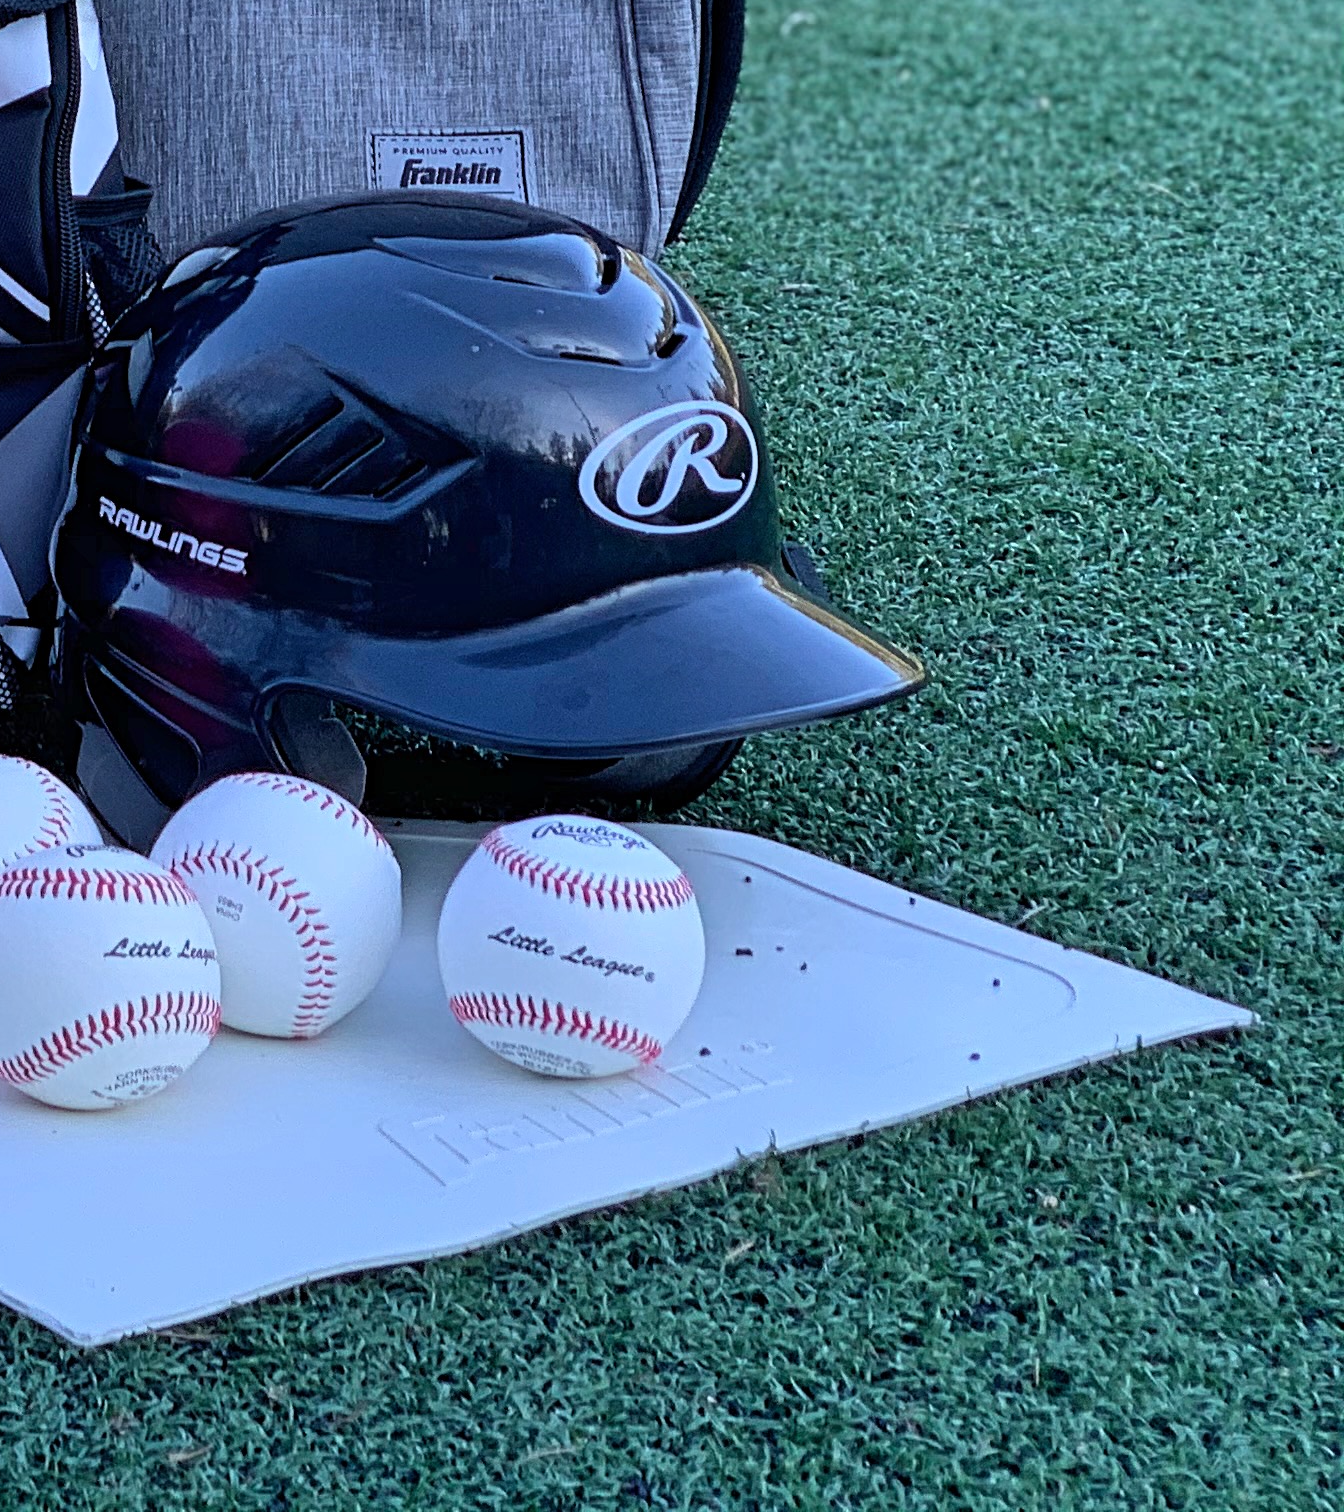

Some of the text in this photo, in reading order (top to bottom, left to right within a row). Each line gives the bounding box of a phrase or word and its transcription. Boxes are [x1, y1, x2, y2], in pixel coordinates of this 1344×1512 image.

[393, 146, 504, 156] PREMIUM QUALITY
[399, 158, 502, 188] Franklin
[99, 495, 249, 576] RAWLINGS
[531, 821, 650, 851] Rawlings
[103, 937, 171, 958] Little
[487, 926, 555, 957] Little
